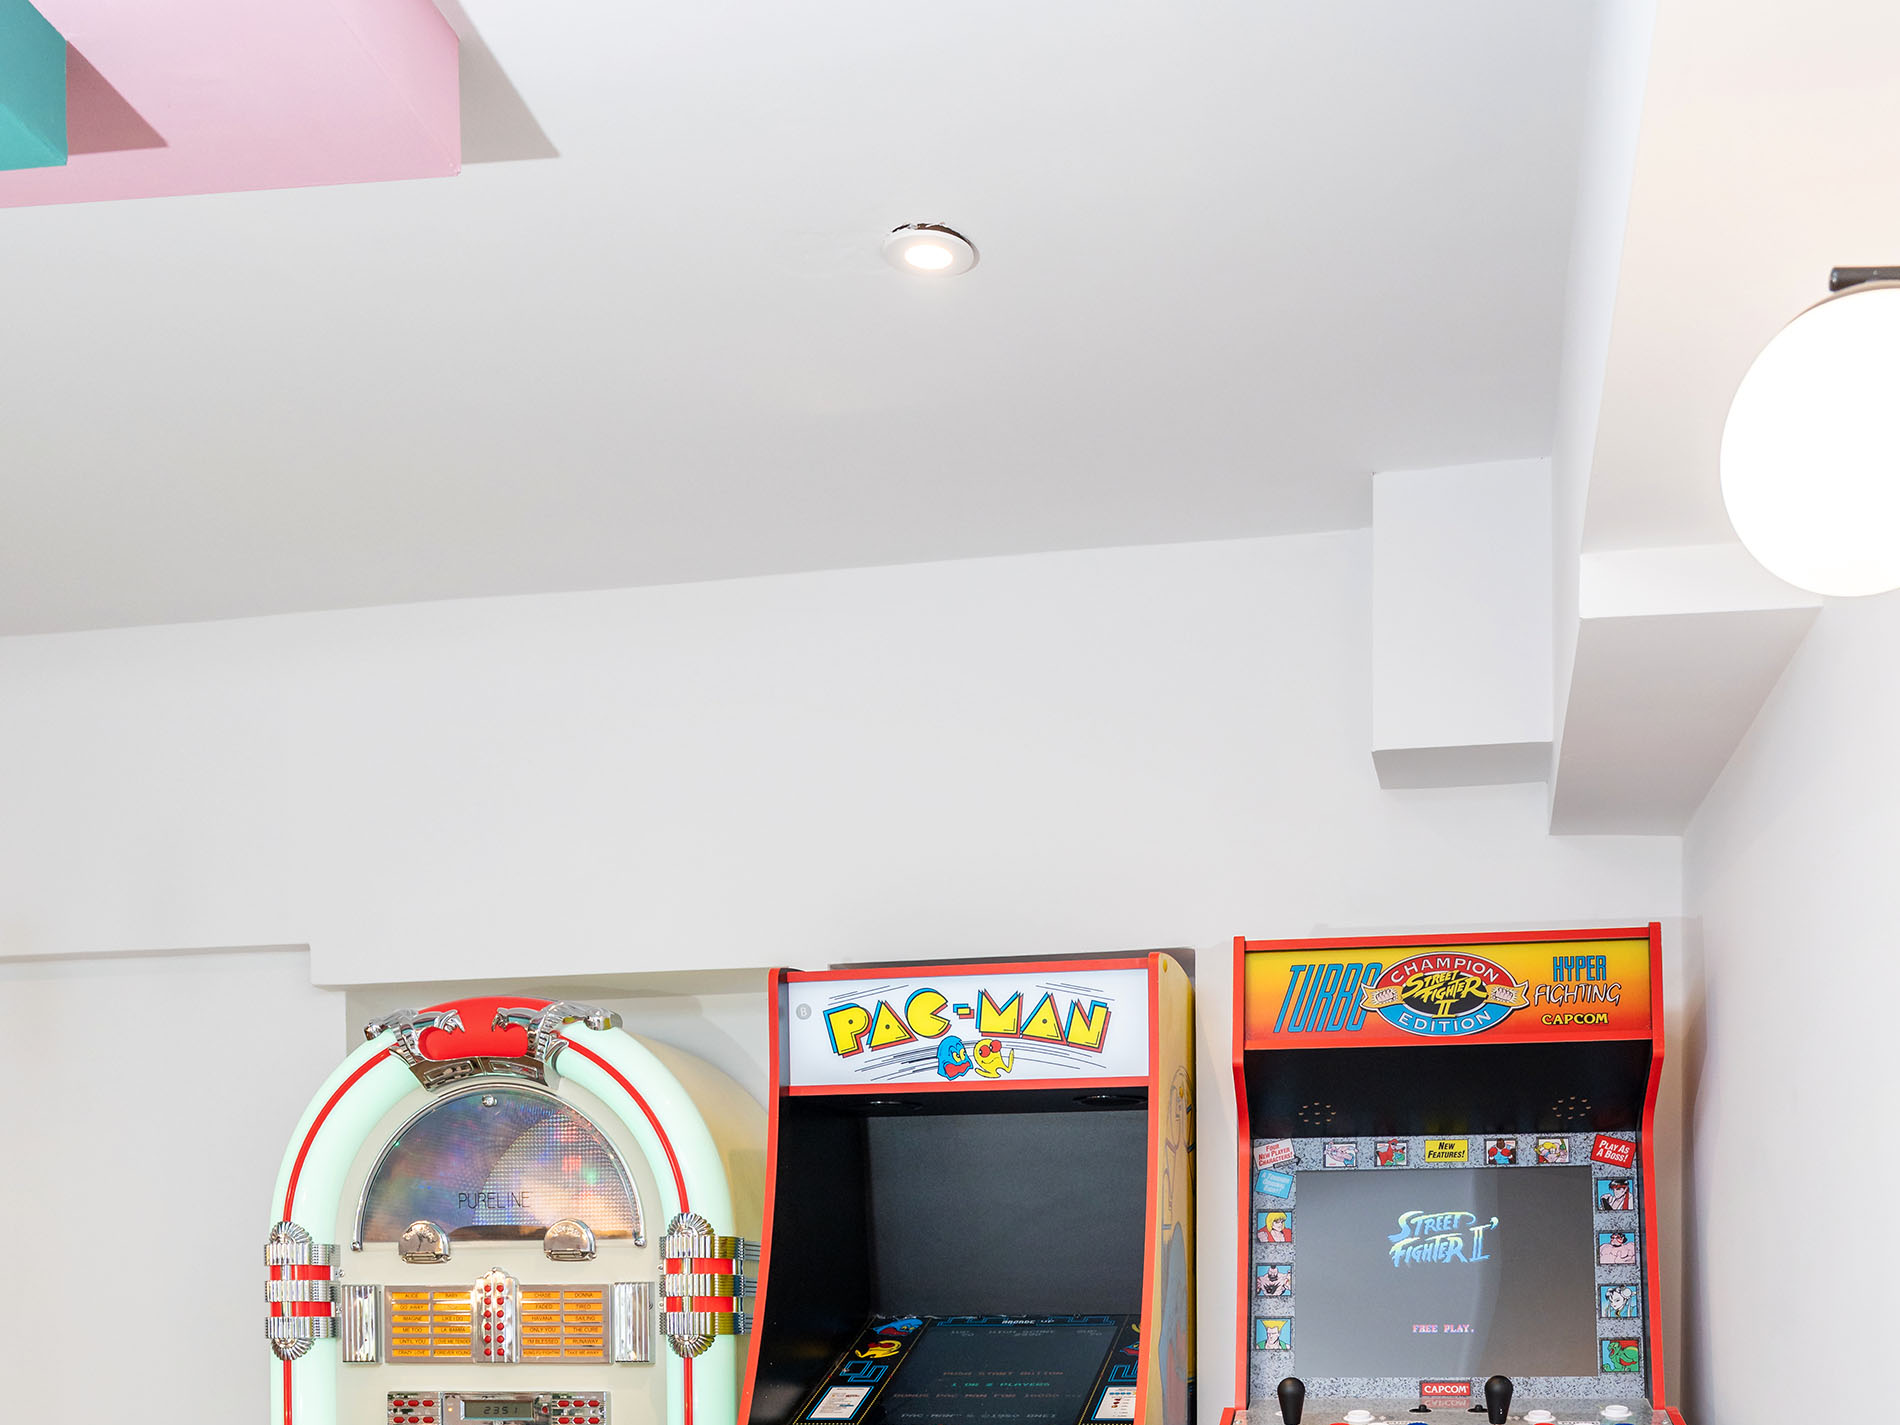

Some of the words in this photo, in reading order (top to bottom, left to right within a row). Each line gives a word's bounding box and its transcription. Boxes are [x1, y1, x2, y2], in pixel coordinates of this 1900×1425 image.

[1390, 957, 1500, 984] CHAMPION
[1552, 954, 1607, 982] HYPER
[1401, 970, 1460, 999] STREET
[1412, 976, 1488, 1004] FIGHTER
[1534, 982, 1622, 1007] FIGHTING
[1273, 962, 1383, 1033] TURBO
[1431, 999, 1460, 1018] II
[822, 987, 1112, 1057] PAC-MAN
[1398, 1010, 1492, 1033] EDITION
[1541, 1013, 1609, 1025] CAPCOM
[1427, 1150, 1466, 1159] FEATURES!
[1437, 1141, 1456, 1150] NEW
[1596, 1148, 1604, 1157] A
[1604, 1150, 1629, 1163] BOSS!
[1599, 1139, 1619, 1152] PLAY
[1617, 1144, 1631, 1155] AS
[458, 1191, 531, 1209] PURELINE
[1387, 1210, 1477, 1243] STREET
[1389, 1232, 1469, 1268] FIGHTER
[1412, 1323, 1439, 1334] FREE
[1423, 1385, 1468, 1394] CAPCOM
